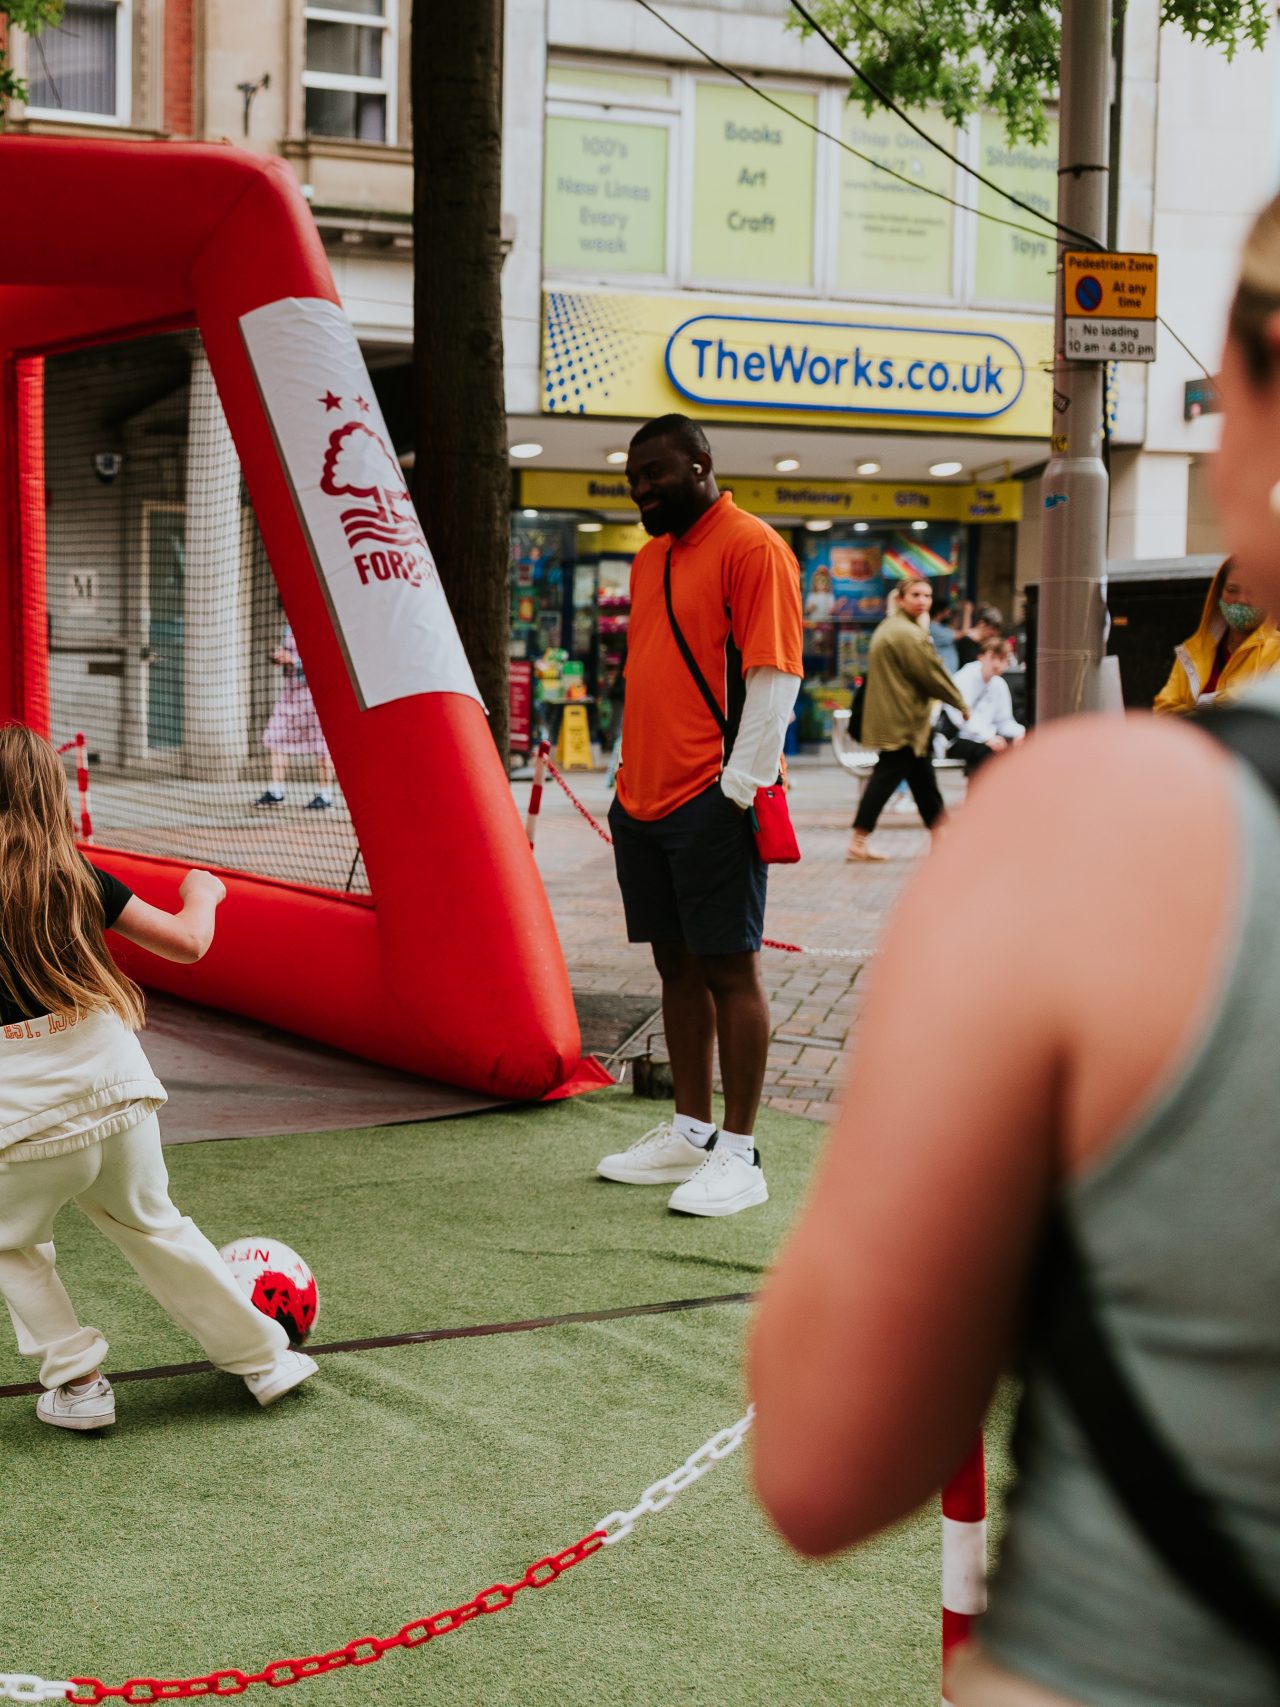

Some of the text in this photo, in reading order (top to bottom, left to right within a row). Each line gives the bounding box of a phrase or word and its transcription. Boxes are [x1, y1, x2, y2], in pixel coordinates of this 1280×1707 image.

[724, 121, 782, 146] Books
[738, 167, 767, 187] Art
[580, 206, 628, 231] Every
[727, 210, 775, 233] Craft
[1011, 234, 1047, 259] Toys
[1069, 257, 1154, 271] Pedestrian Zone
[1113, 282, 1147, 296] At any
[1119, 298, 1142, 308] time
[1083, 324, 1139, 339] No loading
[1068, 341, 1081, 352] 10
[1084, 343, 1099, 353] am
[1109, 343, 1135, 353] 4.30
[1138, 345, 1153, 355] pm
[692, 340, 1002, 394] TheWorks.co.uk
[776, 488, 852, 508] Stationery
[894, 492, 929, 507] Gifts
